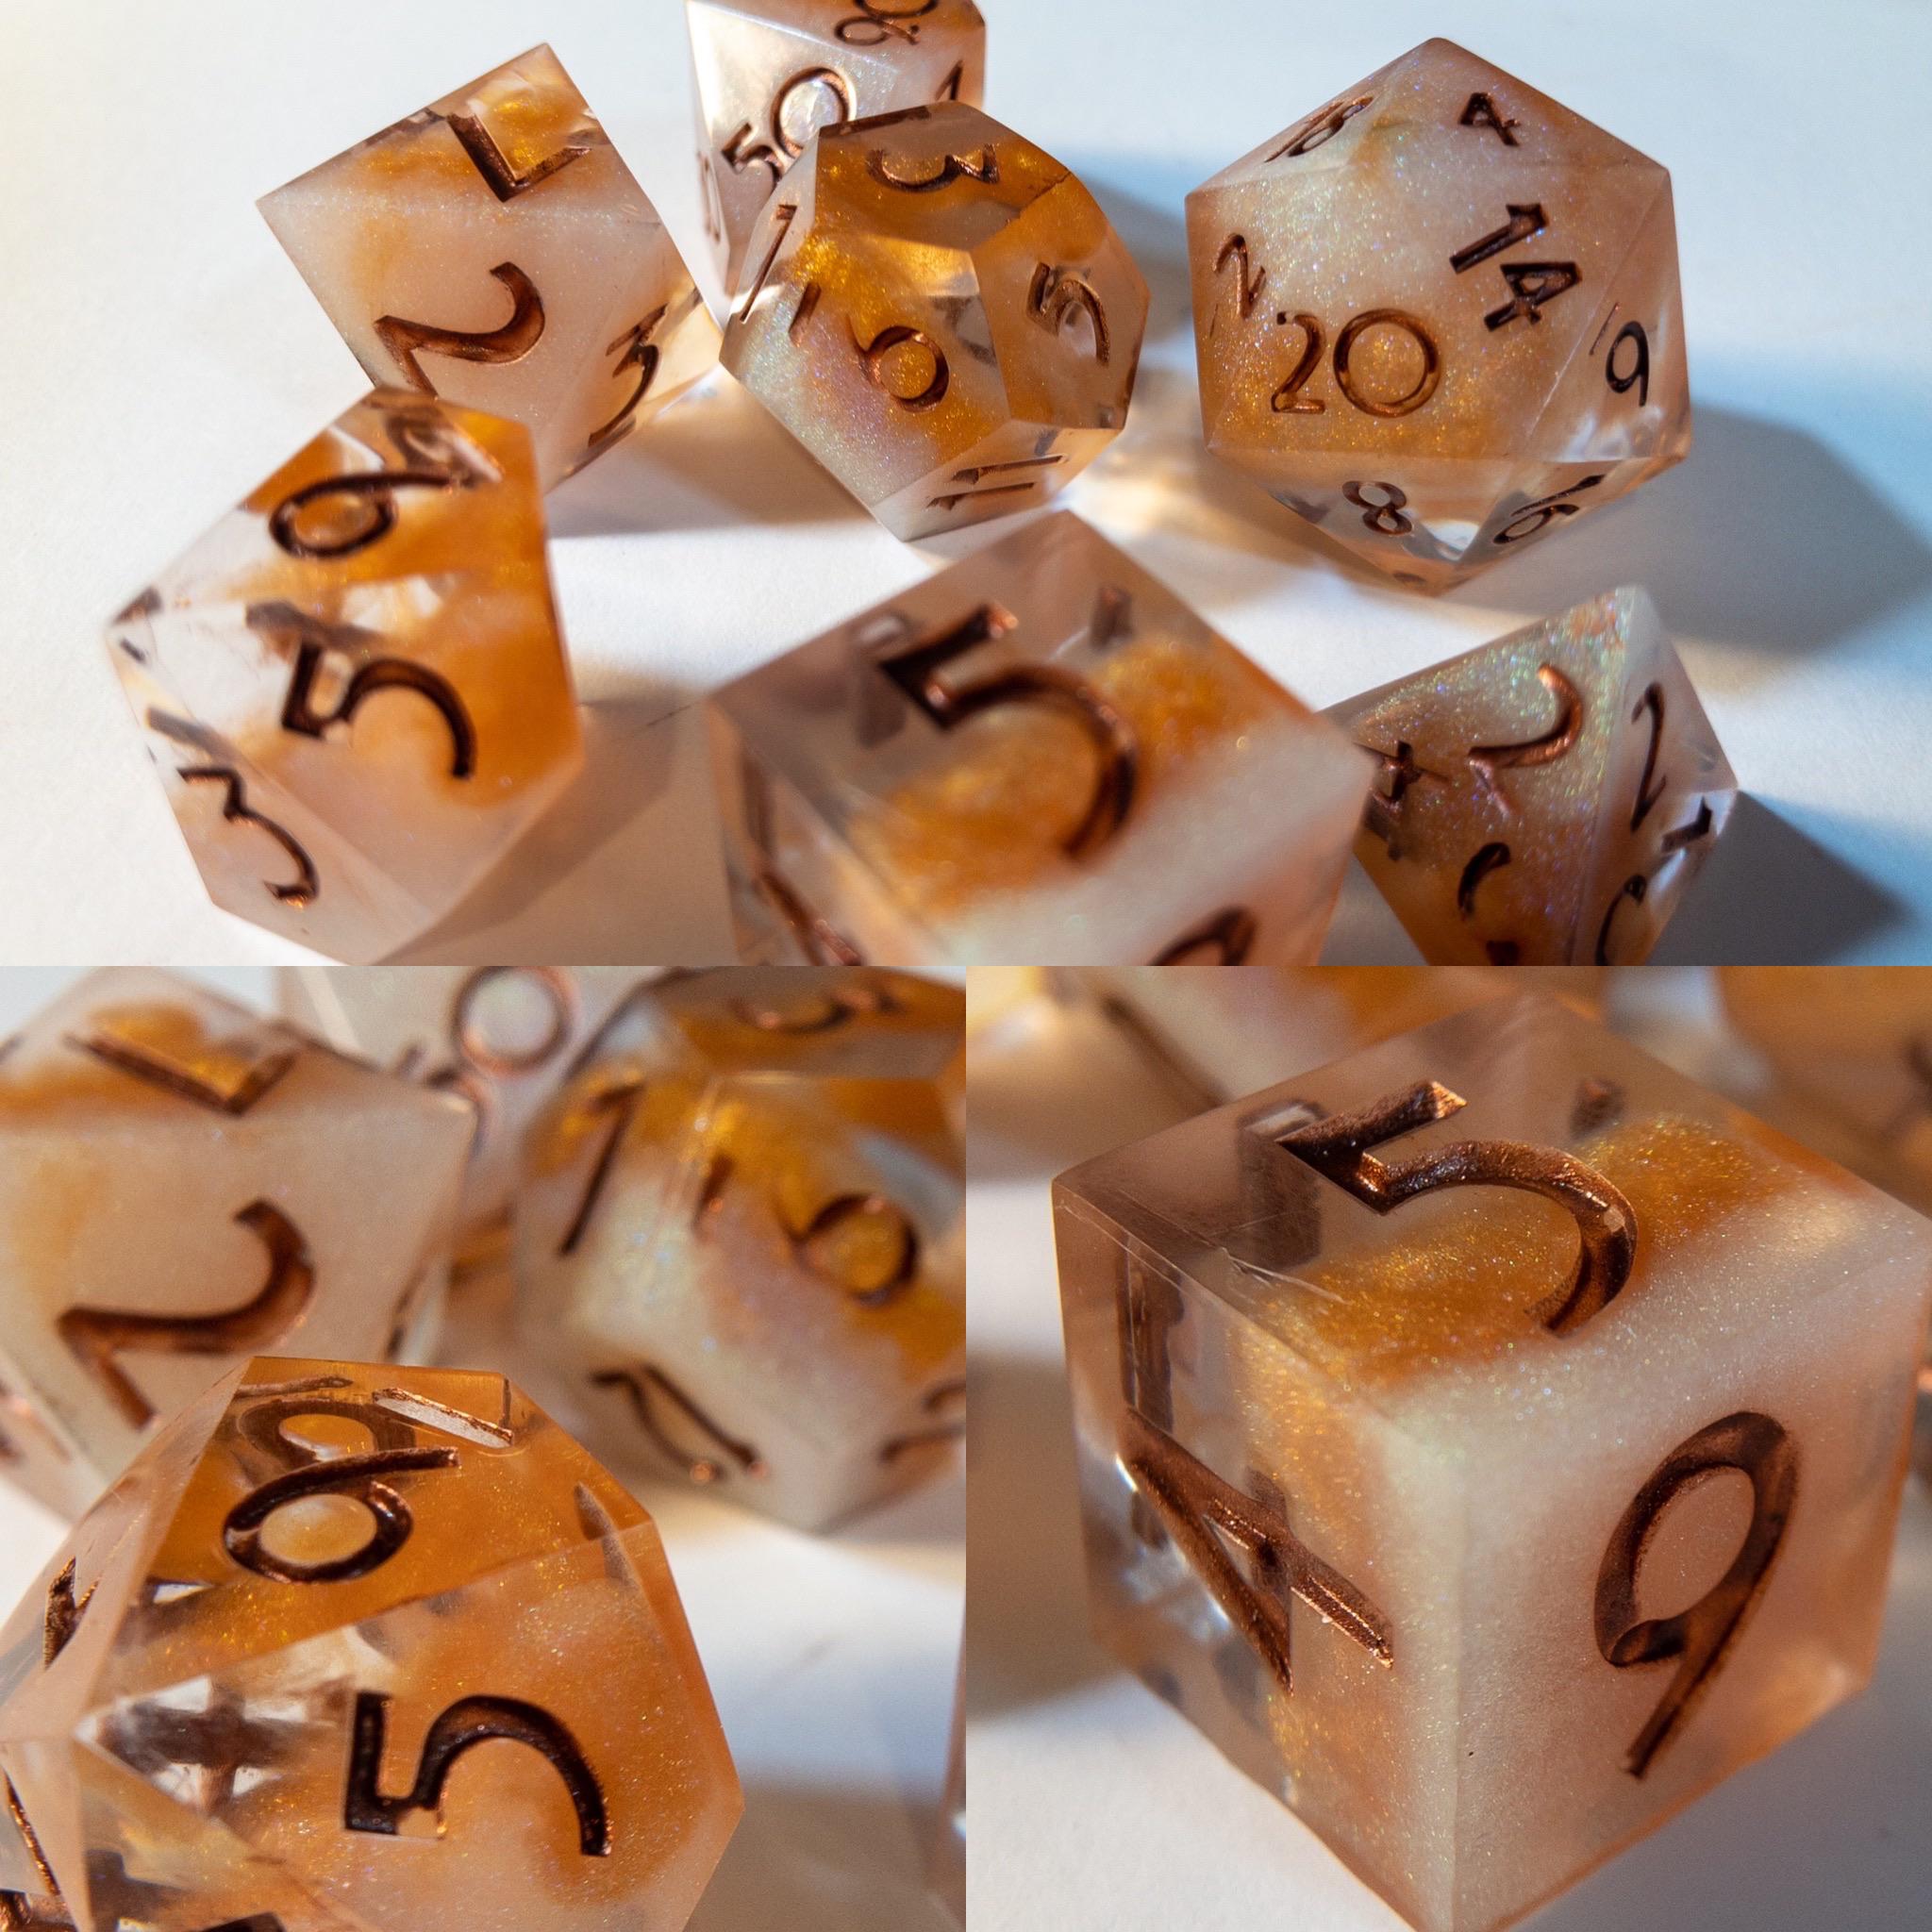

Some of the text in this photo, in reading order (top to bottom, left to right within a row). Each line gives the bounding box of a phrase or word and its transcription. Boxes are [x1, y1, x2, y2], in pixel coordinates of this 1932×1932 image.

[375, 261, 545, 400] 2
[1027, 262, 1110, 366] 5
[1449, 203, 1582, 332] 14
[1271, 308, 1440, 417] 20
[1341, 480, 1413, 535] 8
[281, 634, 477, 779] 5
[877, 599, 1140, 864] 5
[1467, 662, 1583, 816] 2
[177, 766, 320, 910] 3
[1275, 1079, 1638, 1336] 5
[57, 1196, 318, 1430] 2
[343, 1692, 612, 1857] 5
